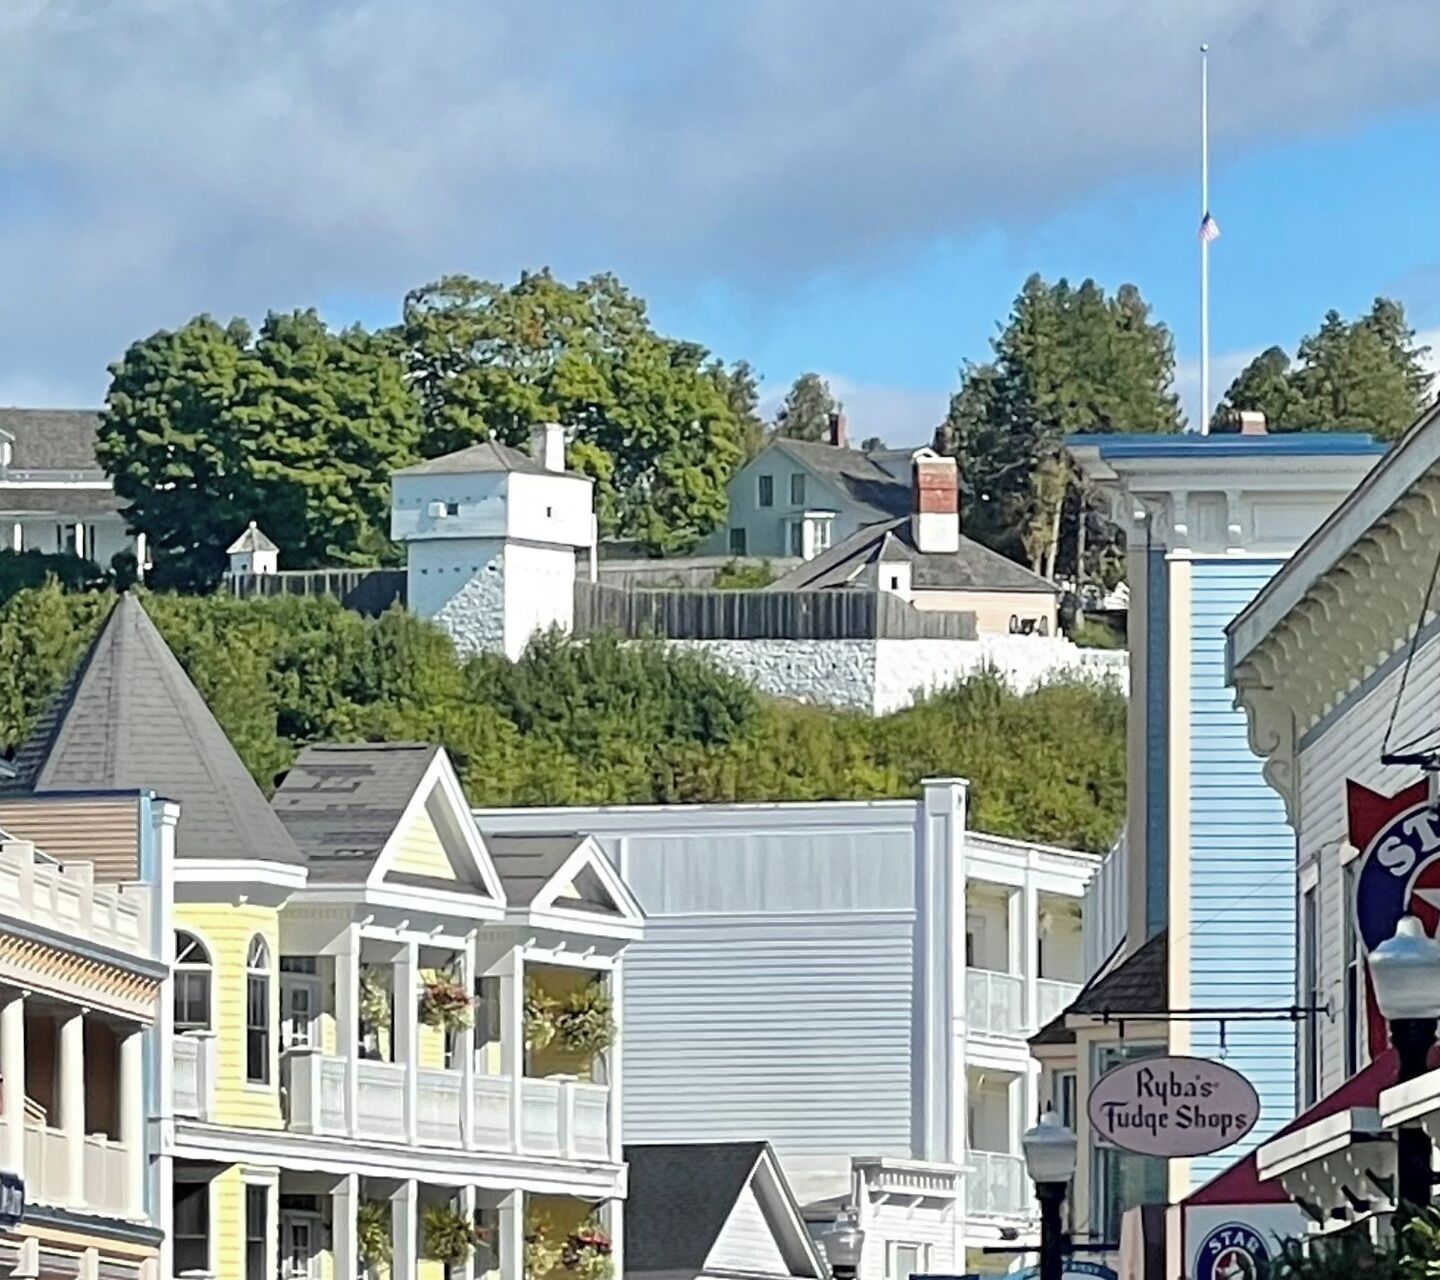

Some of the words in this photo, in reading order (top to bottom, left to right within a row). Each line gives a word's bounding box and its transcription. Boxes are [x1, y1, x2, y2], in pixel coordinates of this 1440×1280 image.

[1136, 1067, 1213, 1106] Ryba's
[1100, 1101, 1169, 1137] Fudge
[1175, 1104, 1248, 1137] Shops
